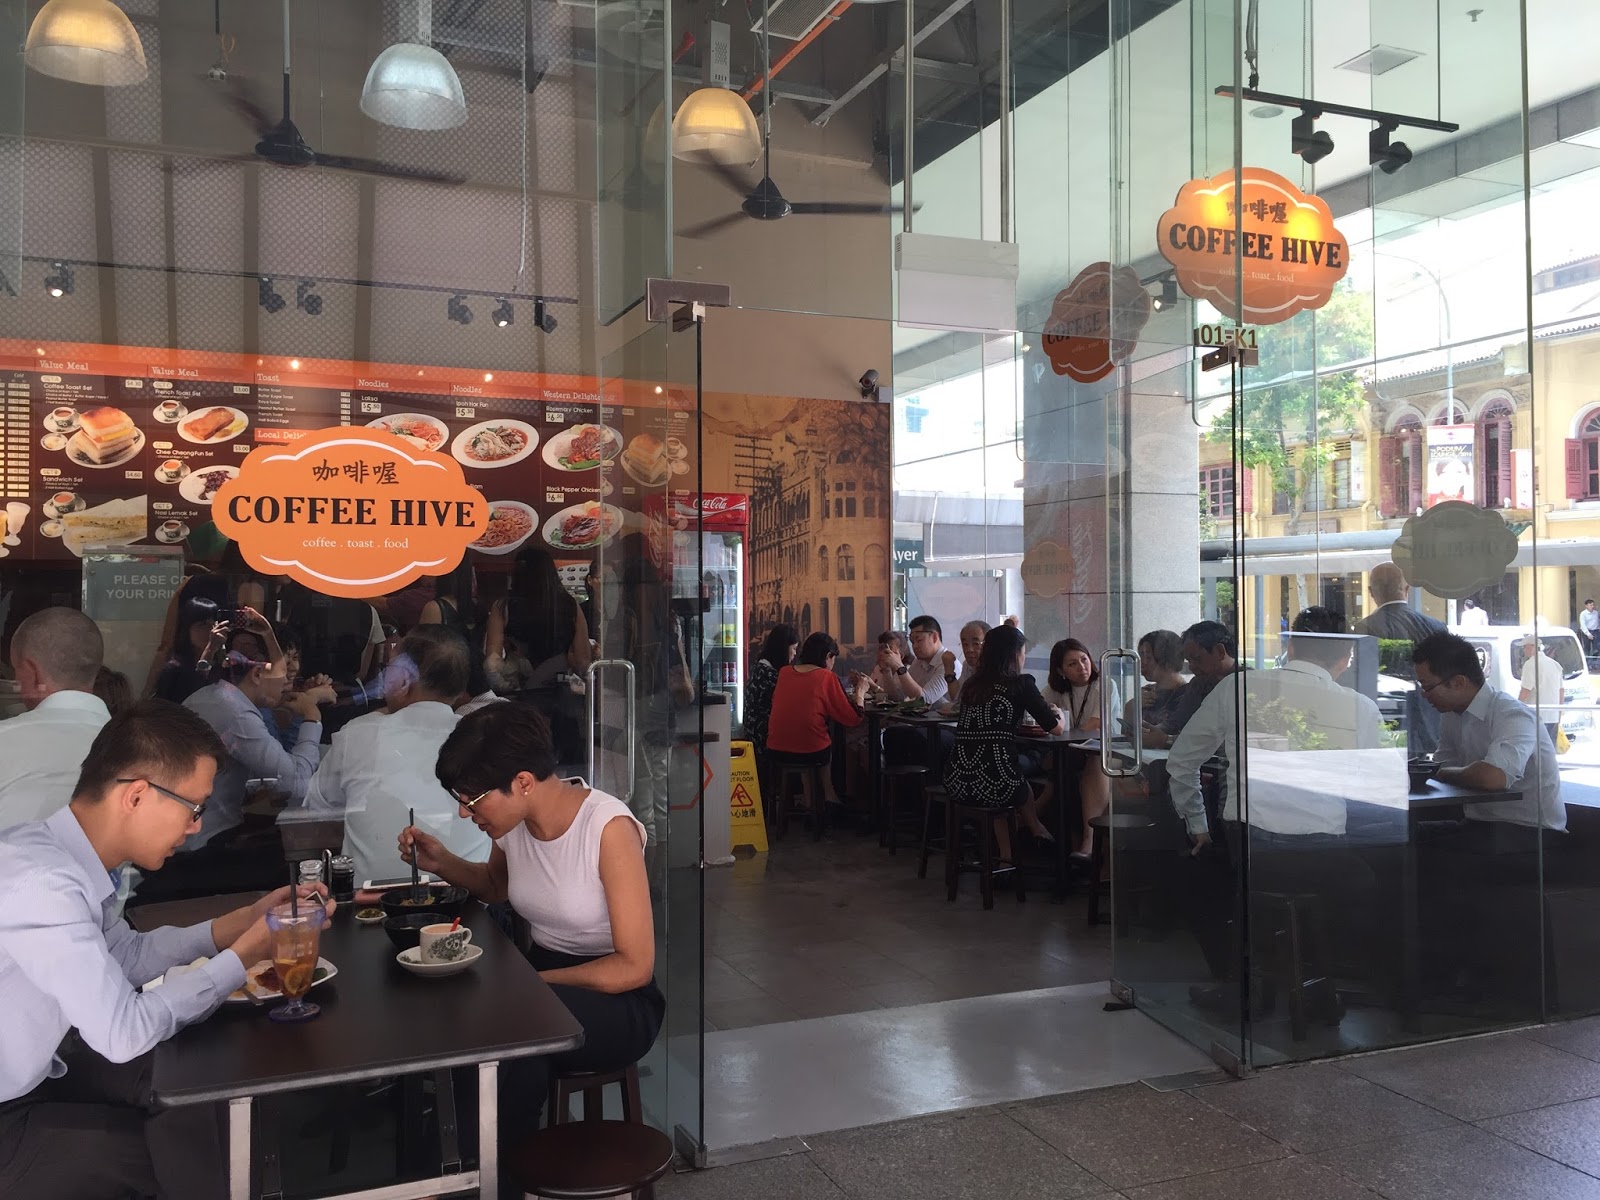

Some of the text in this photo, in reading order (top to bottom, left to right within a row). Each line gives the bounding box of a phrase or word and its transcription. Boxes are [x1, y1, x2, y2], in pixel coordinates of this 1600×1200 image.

[1169, 222, 1342, 269] COFFEE HIVE
[1219, 267, 1294, 282] coffe toast food
[1200, 324, 1258, 349] 01-K1
[39, 360, 89, 371] Value Meal
[151, 366, 199, 377] Value Meal
[256, 373, 280, 381] Toast
[358, 379, 389, 388] Noodles
[452, 385, 482, 394] Noodles
[543, 390, 571, 399] Western
[546, 405, 572, 413] Rosemary
[257, 430, 306, 439] Local Deli
[312, 458, 400, 485] 咖啡喔
[692, 496, 728, 509] Cca-Cola
[228, 494, 476, 529] COFFEE HIVE
[302, 536, 409, 549] coffee toast food
[113, 575, 166, 585] PLEASE
[106, 589, 145, 599] YOUR
